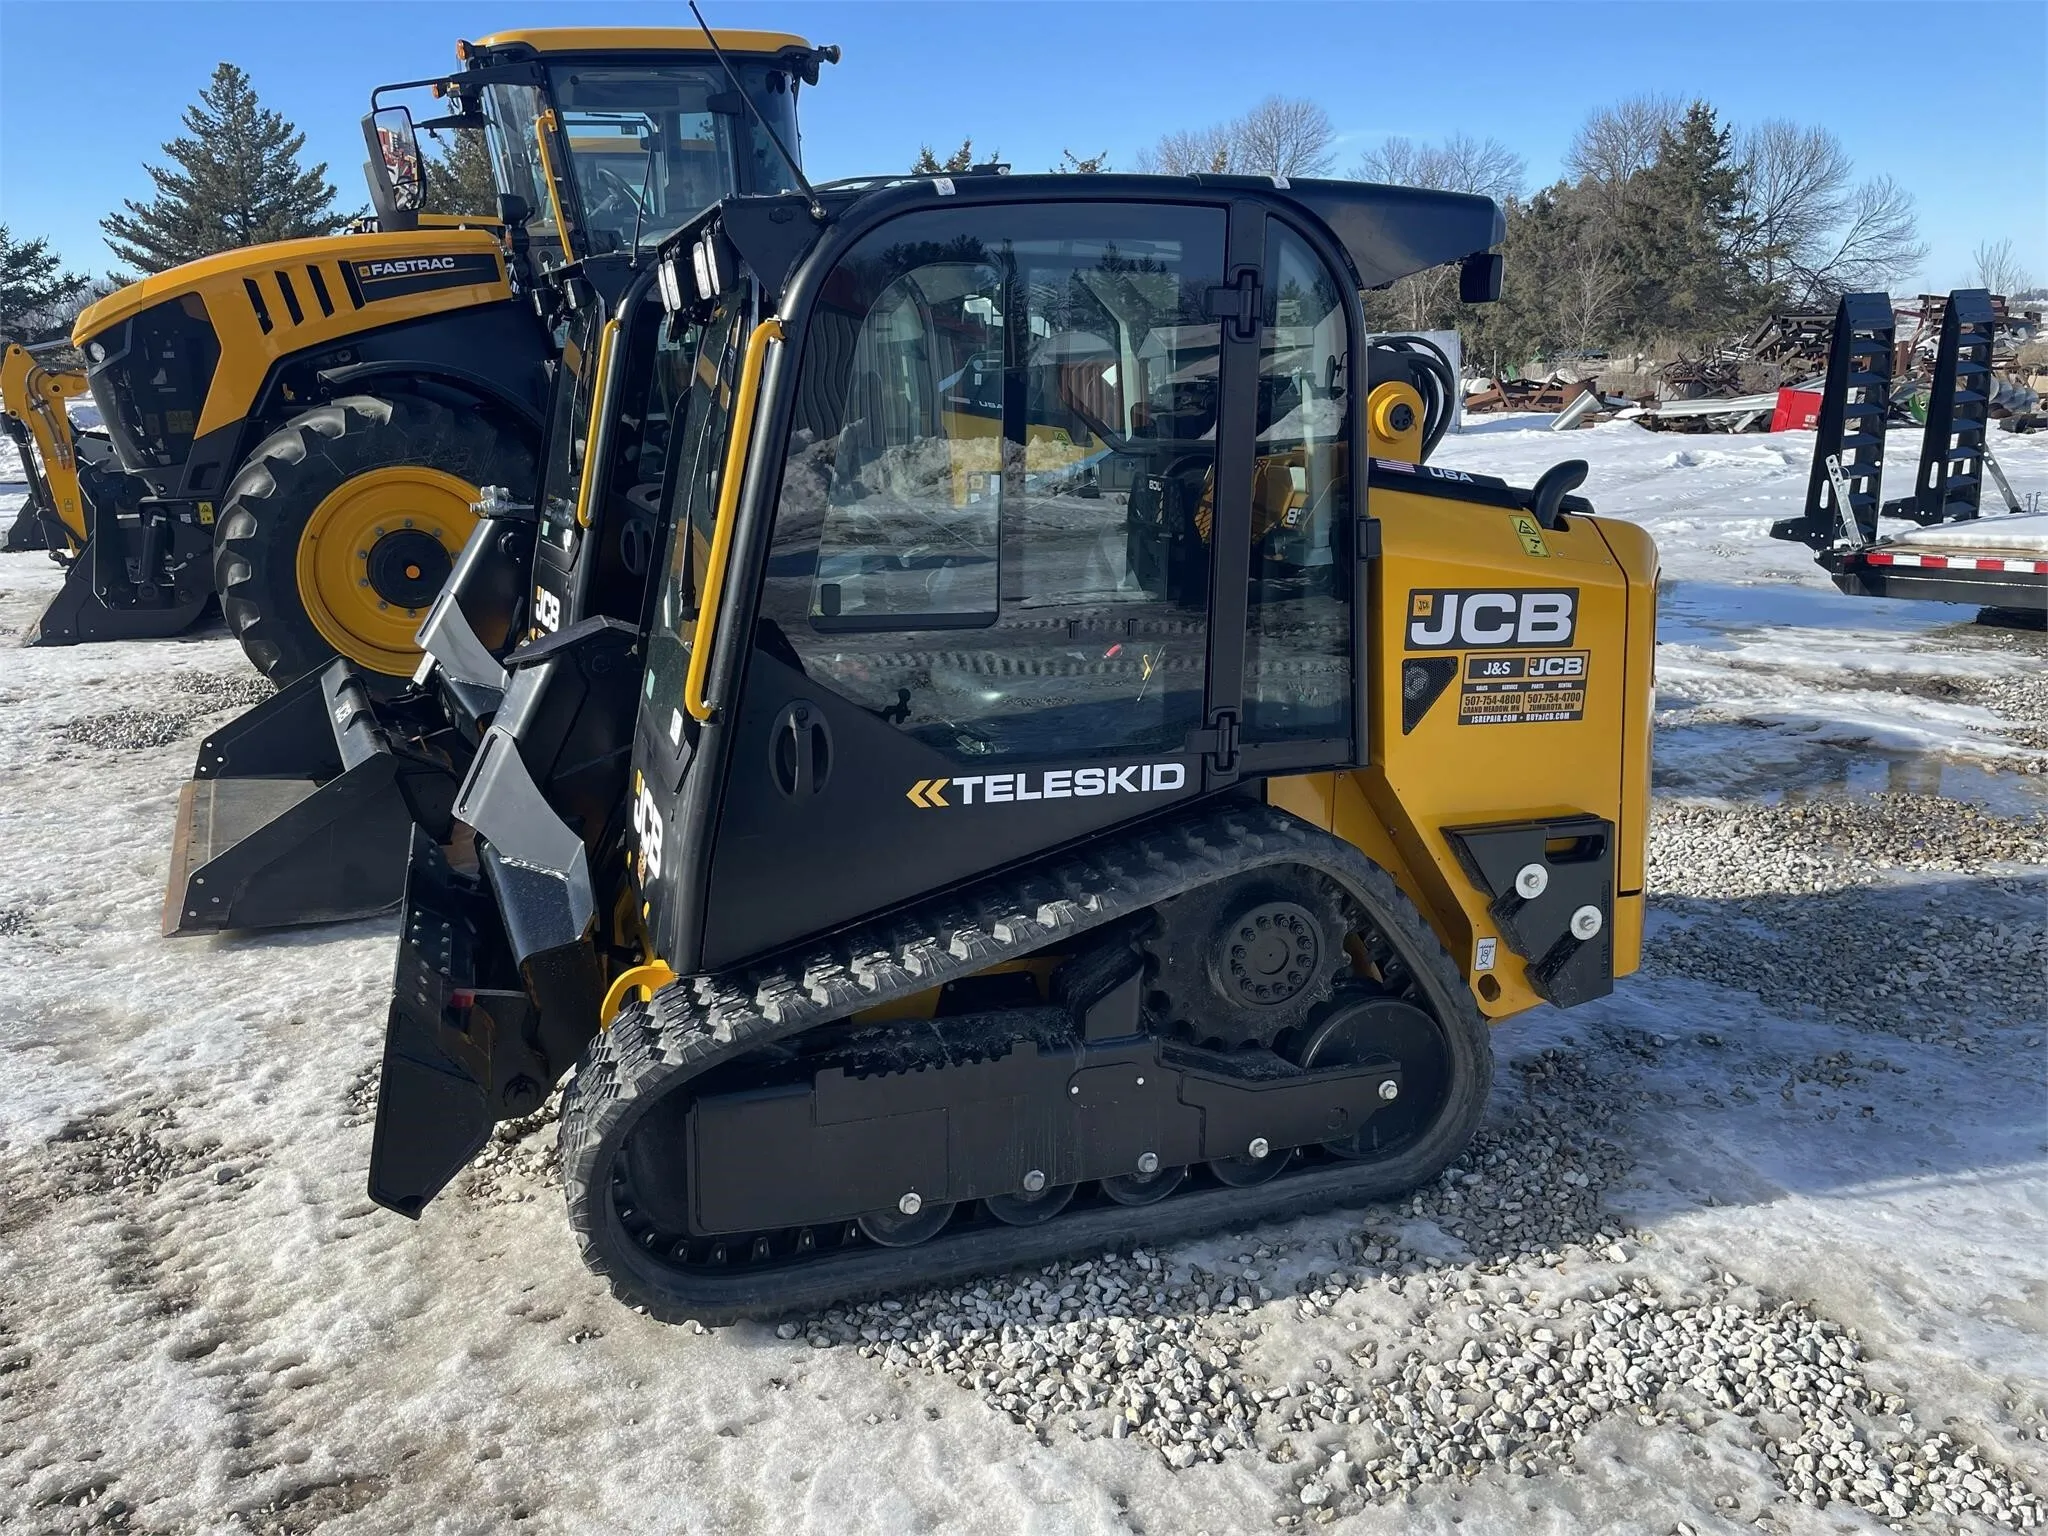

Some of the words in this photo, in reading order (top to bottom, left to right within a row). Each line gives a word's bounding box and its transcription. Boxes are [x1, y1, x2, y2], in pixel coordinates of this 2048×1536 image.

[371, 257, 455, 276] FASTRAC
[1429, 467, 1475, 483] USA
[536, 587, 560, 633] JCB
[1411, 593, 1573, 645] JCB
[1483, 661, 1511, 676] J&S
[1529, 657, 1582, 676] JCB
[1465, 694, 1521, 706] 507-754-4800
[1527, 692, 1581, 704] 507-754-4700
[1471, 714, 1518, 723] JSREPAIR.COM
[953, 763, 1185, 805] TELESKID
[634, 778, 663, 879] JCB
